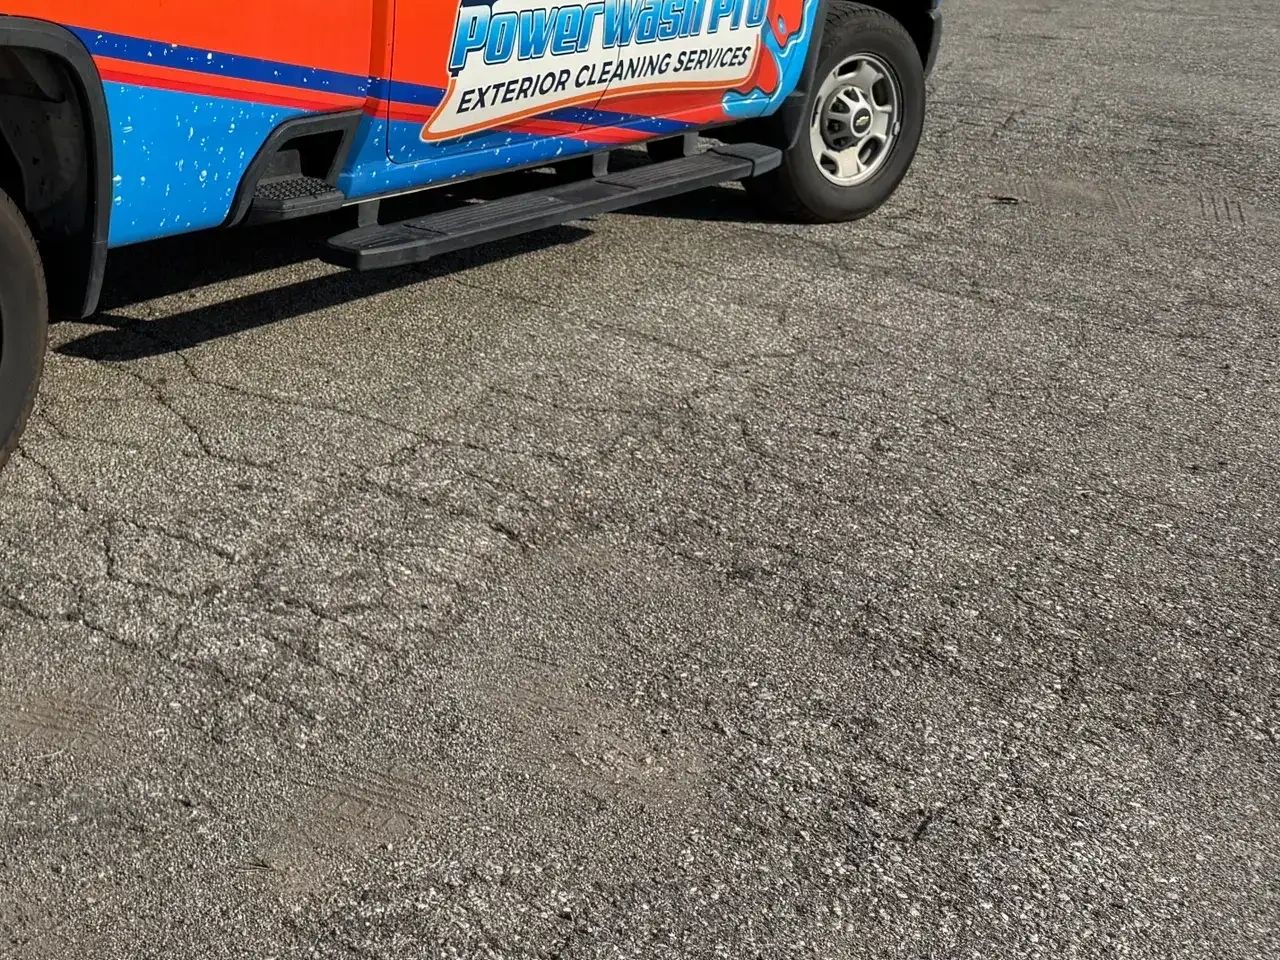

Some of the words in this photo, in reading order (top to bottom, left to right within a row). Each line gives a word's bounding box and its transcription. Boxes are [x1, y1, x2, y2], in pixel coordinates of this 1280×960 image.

[455, 71, 569, 114] EXTERIOR
[574, 55, 671, 88] CLEANING
[673, 46, 750, 73] SERVICES
